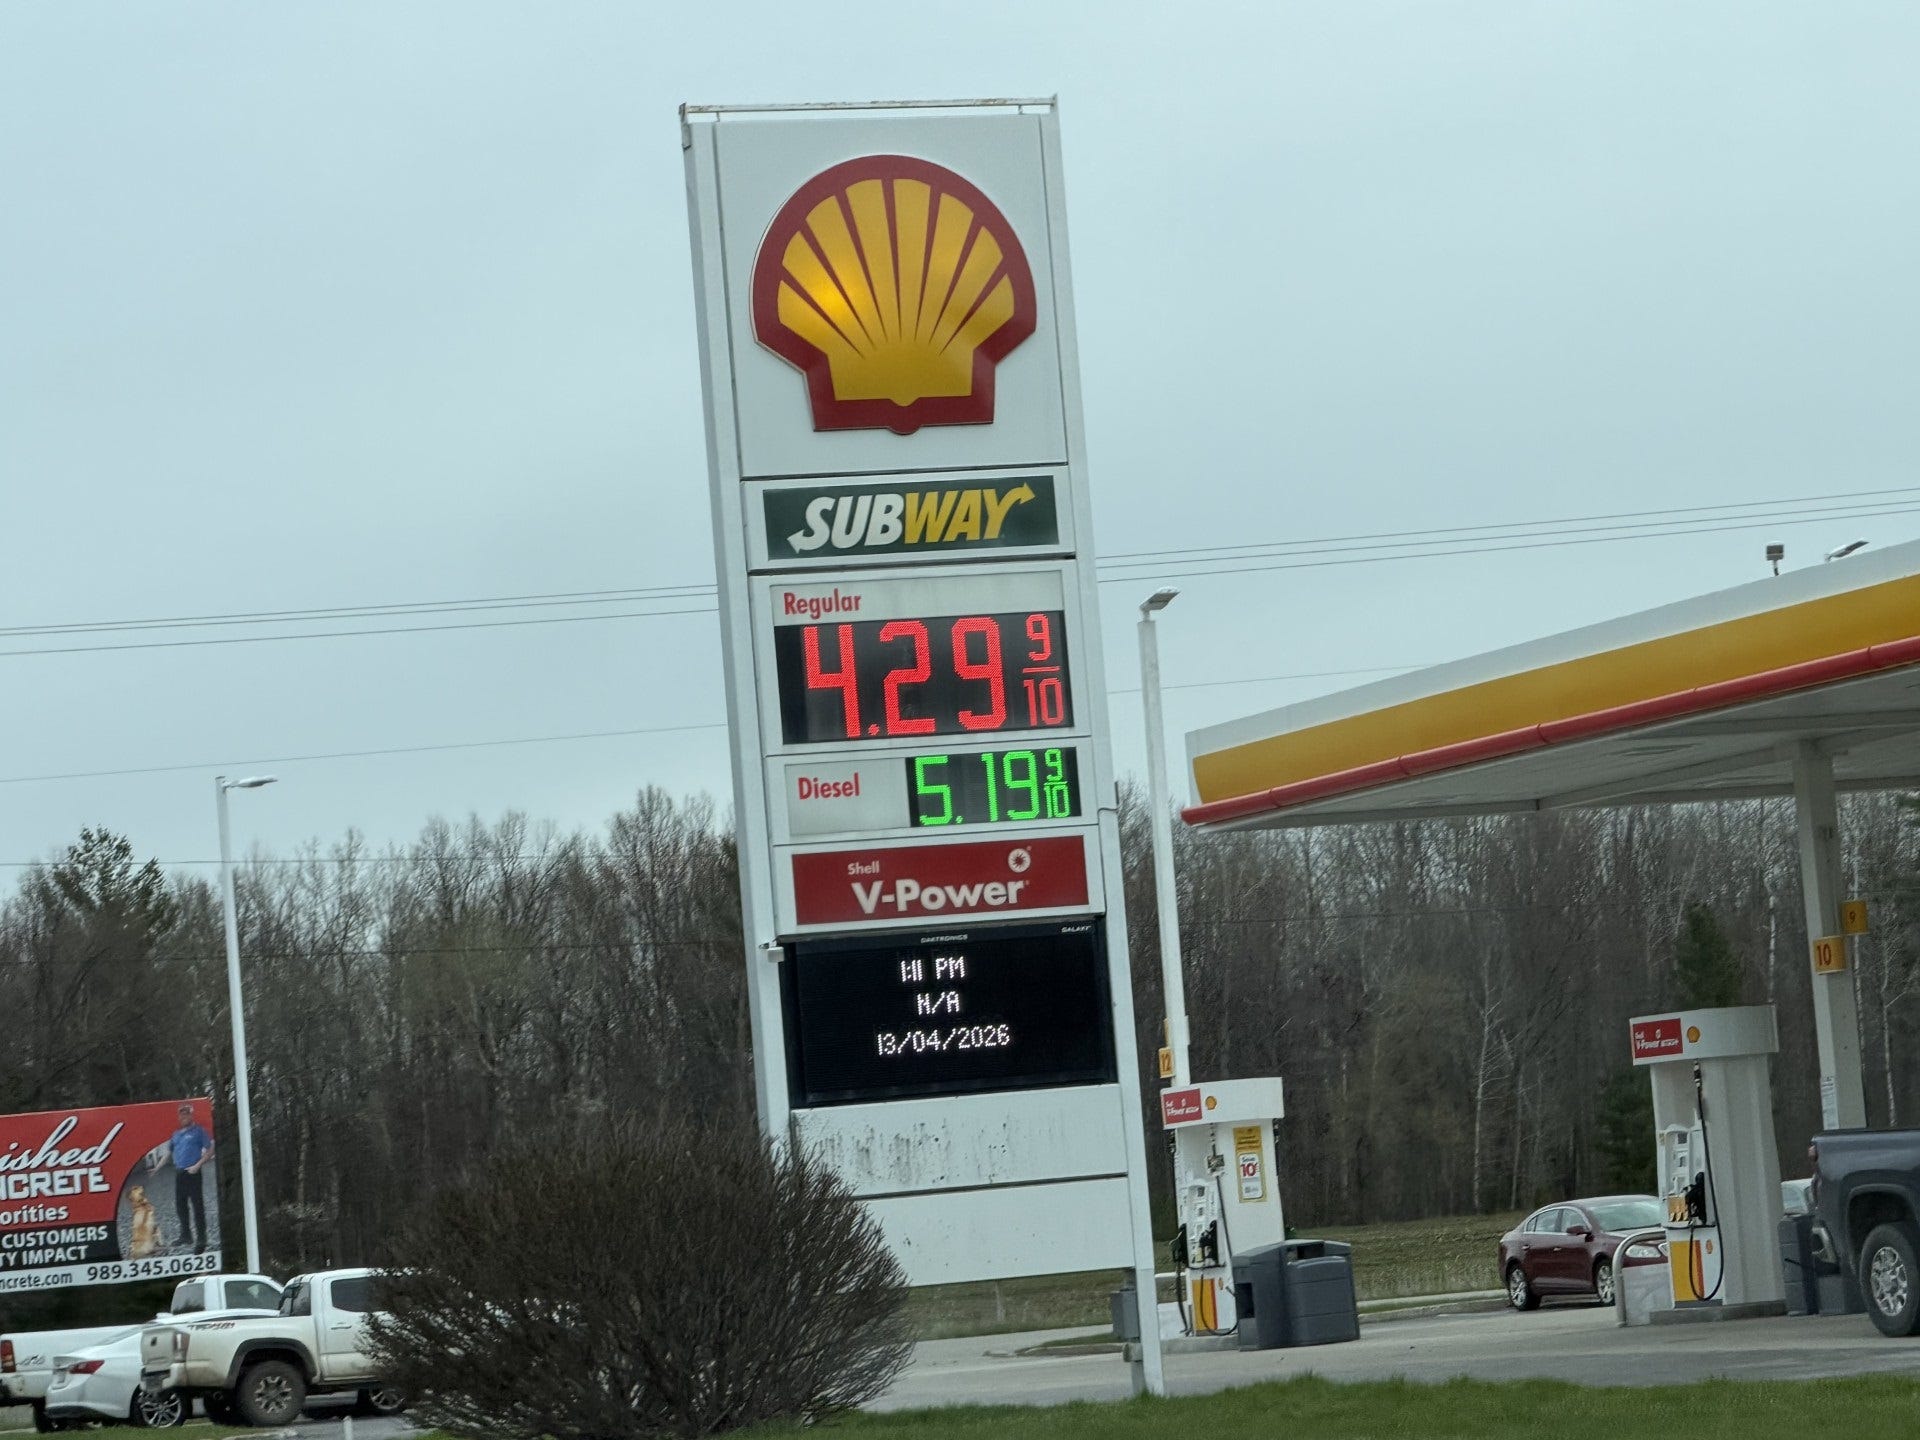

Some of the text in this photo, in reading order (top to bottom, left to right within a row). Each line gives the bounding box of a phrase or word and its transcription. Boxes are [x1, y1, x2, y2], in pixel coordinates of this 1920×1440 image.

[787, 483, 1036, 553] SUBWAY
[784, 588, 861, 619] Regular
[803, 617, 1007, 737] 4.29
[798, 773, 860, 800] Diesel
[914, 751, 1040, 826] 5.19
[848, 861, 880, 875] Shell
[851, 878, 1025, 914] V-Power
[935, 956, 966, 979] PM
[1816, 943, 1832, 967] 10
[917, 991, 960, 1015] N/A
[877, 1024, 1010, 1056] 13/04/2026
[0, 1203, 69, 1225] orities
[2, 1225, 108, 1249] CUSTOMERS
[22, 1245, 89, 1265] IMPACT
[87, 1255, 216, 1281] 989.345.0628
